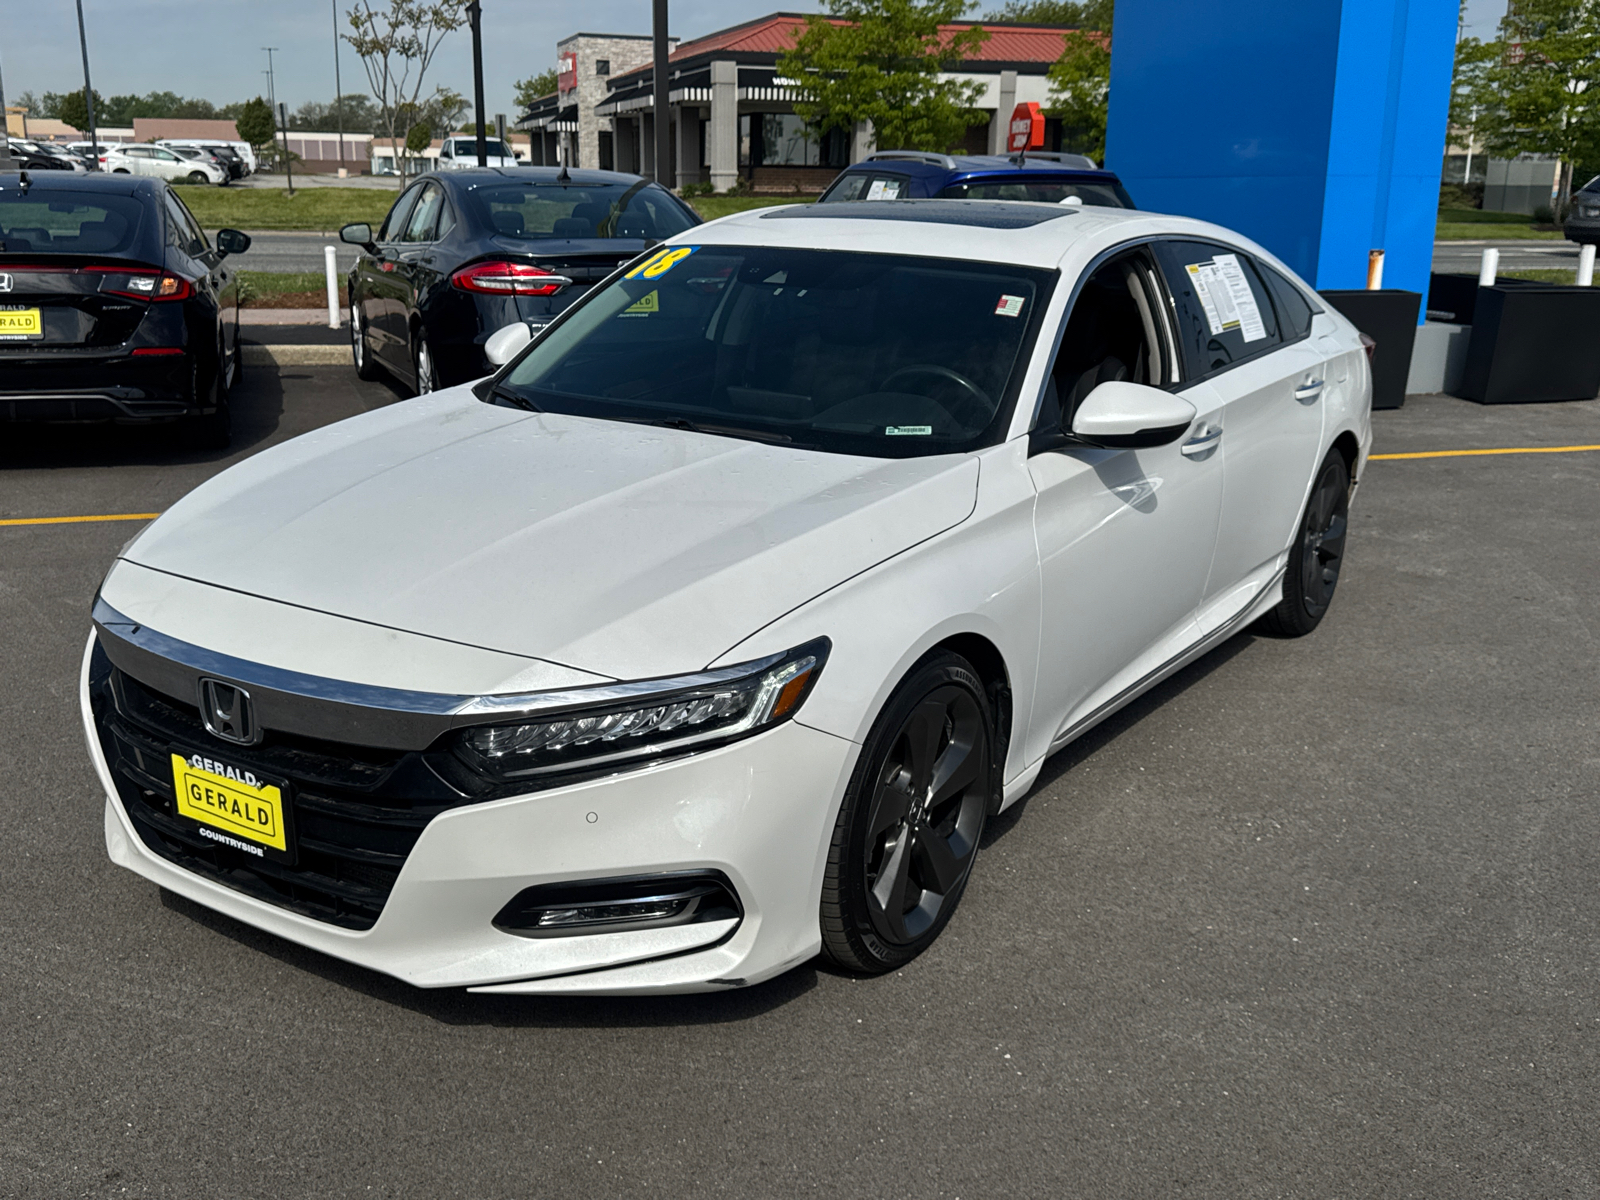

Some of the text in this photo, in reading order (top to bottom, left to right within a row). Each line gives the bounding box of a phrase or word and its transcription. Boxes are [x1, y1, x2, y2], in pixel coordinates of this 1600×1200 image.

[624, 247, 692, 279] 18
[191, 754, 256, 788] GERALD
[190, 783, 270, 826] GERALD
[198, 827, 264, 858] COUNTRYSIDE
